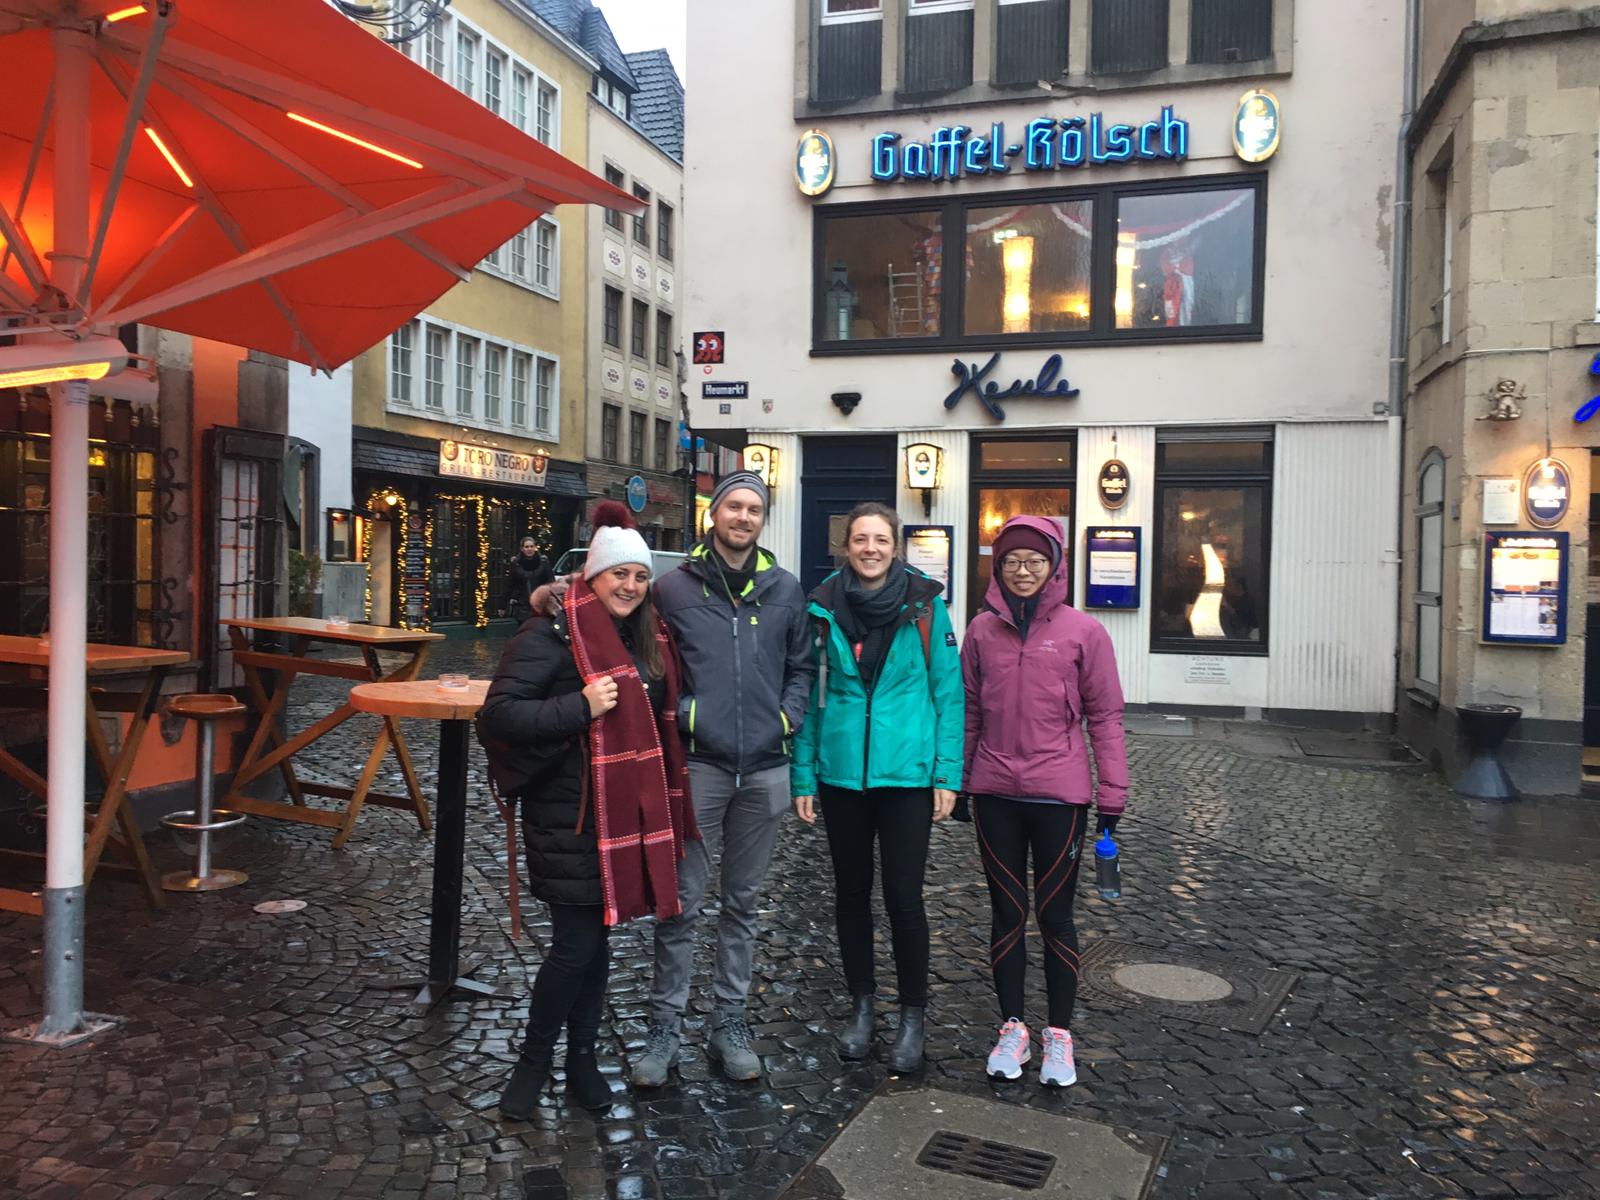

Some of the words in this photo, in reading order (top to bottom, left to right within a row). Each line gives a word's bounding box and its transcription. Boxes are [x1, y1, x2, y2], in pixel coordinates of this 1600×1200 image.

[705, 384, 744, 395] Heumarkt
[944, 352, 1080, 421] Keule
[464, 447, 492, 466] TORO
[494, 453, 529, 472] NEGRO
